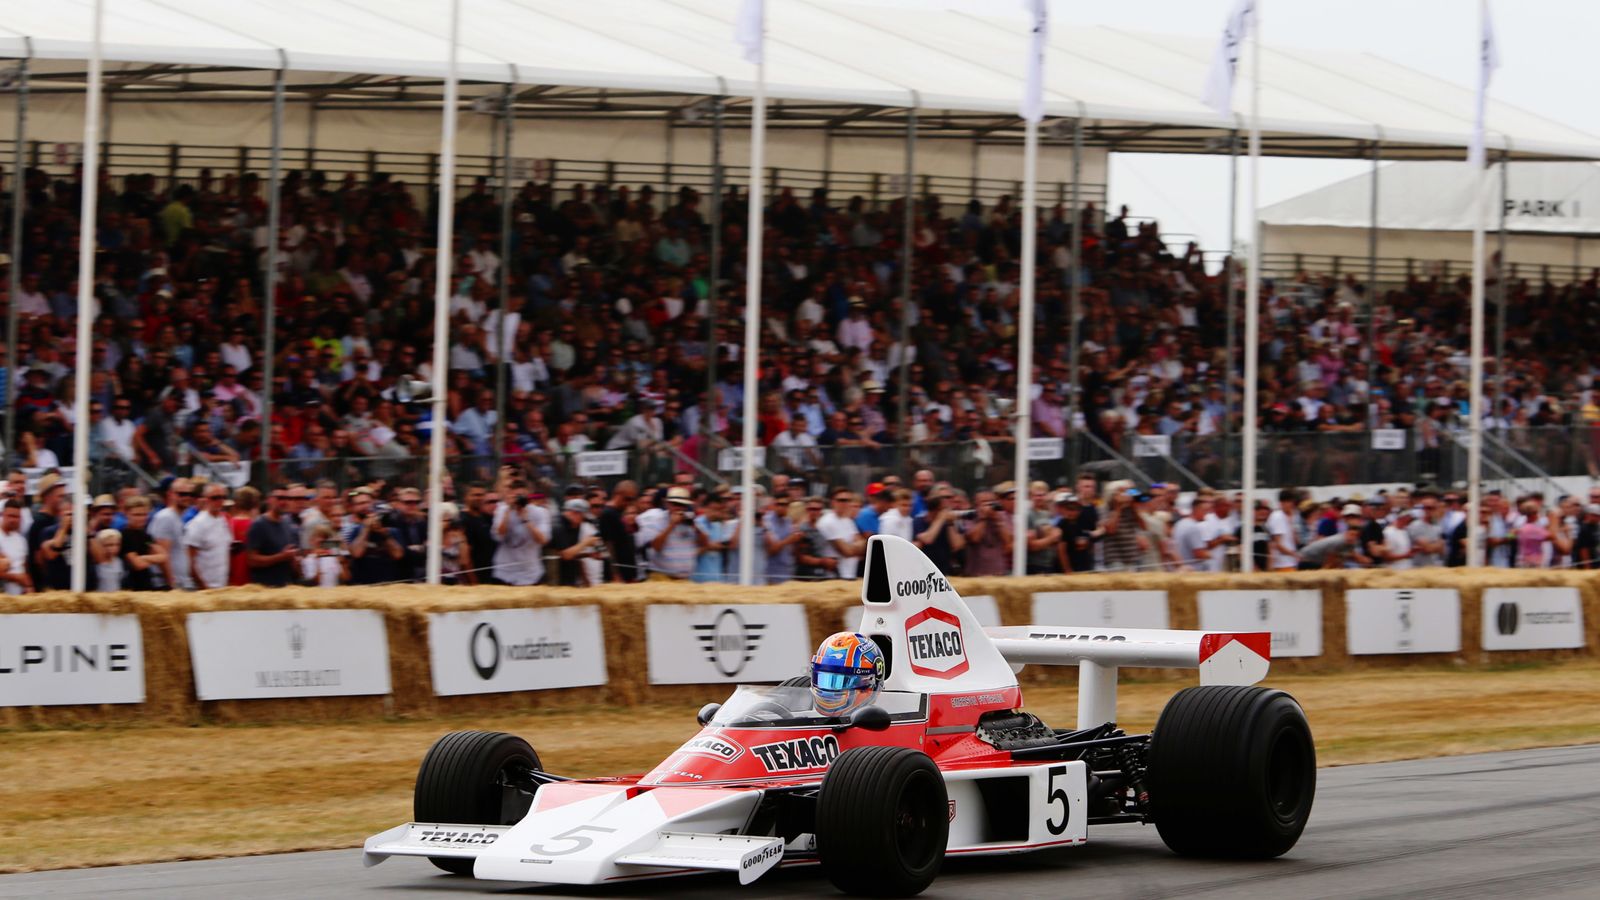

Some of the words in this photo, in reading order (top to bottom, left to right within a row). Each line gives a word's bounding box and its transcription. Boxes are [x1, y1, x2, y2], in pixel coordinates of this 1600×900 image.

[1503, 200, 1565, 216] PARK
[909, 631, 962, 659] TEXACO
[751, 735, 839, 771] TEXACO
[1046, 765, 1070, 836] 5
[419, 831, 499, 845] TEXACO
[529, 825, 617, 857] 5
